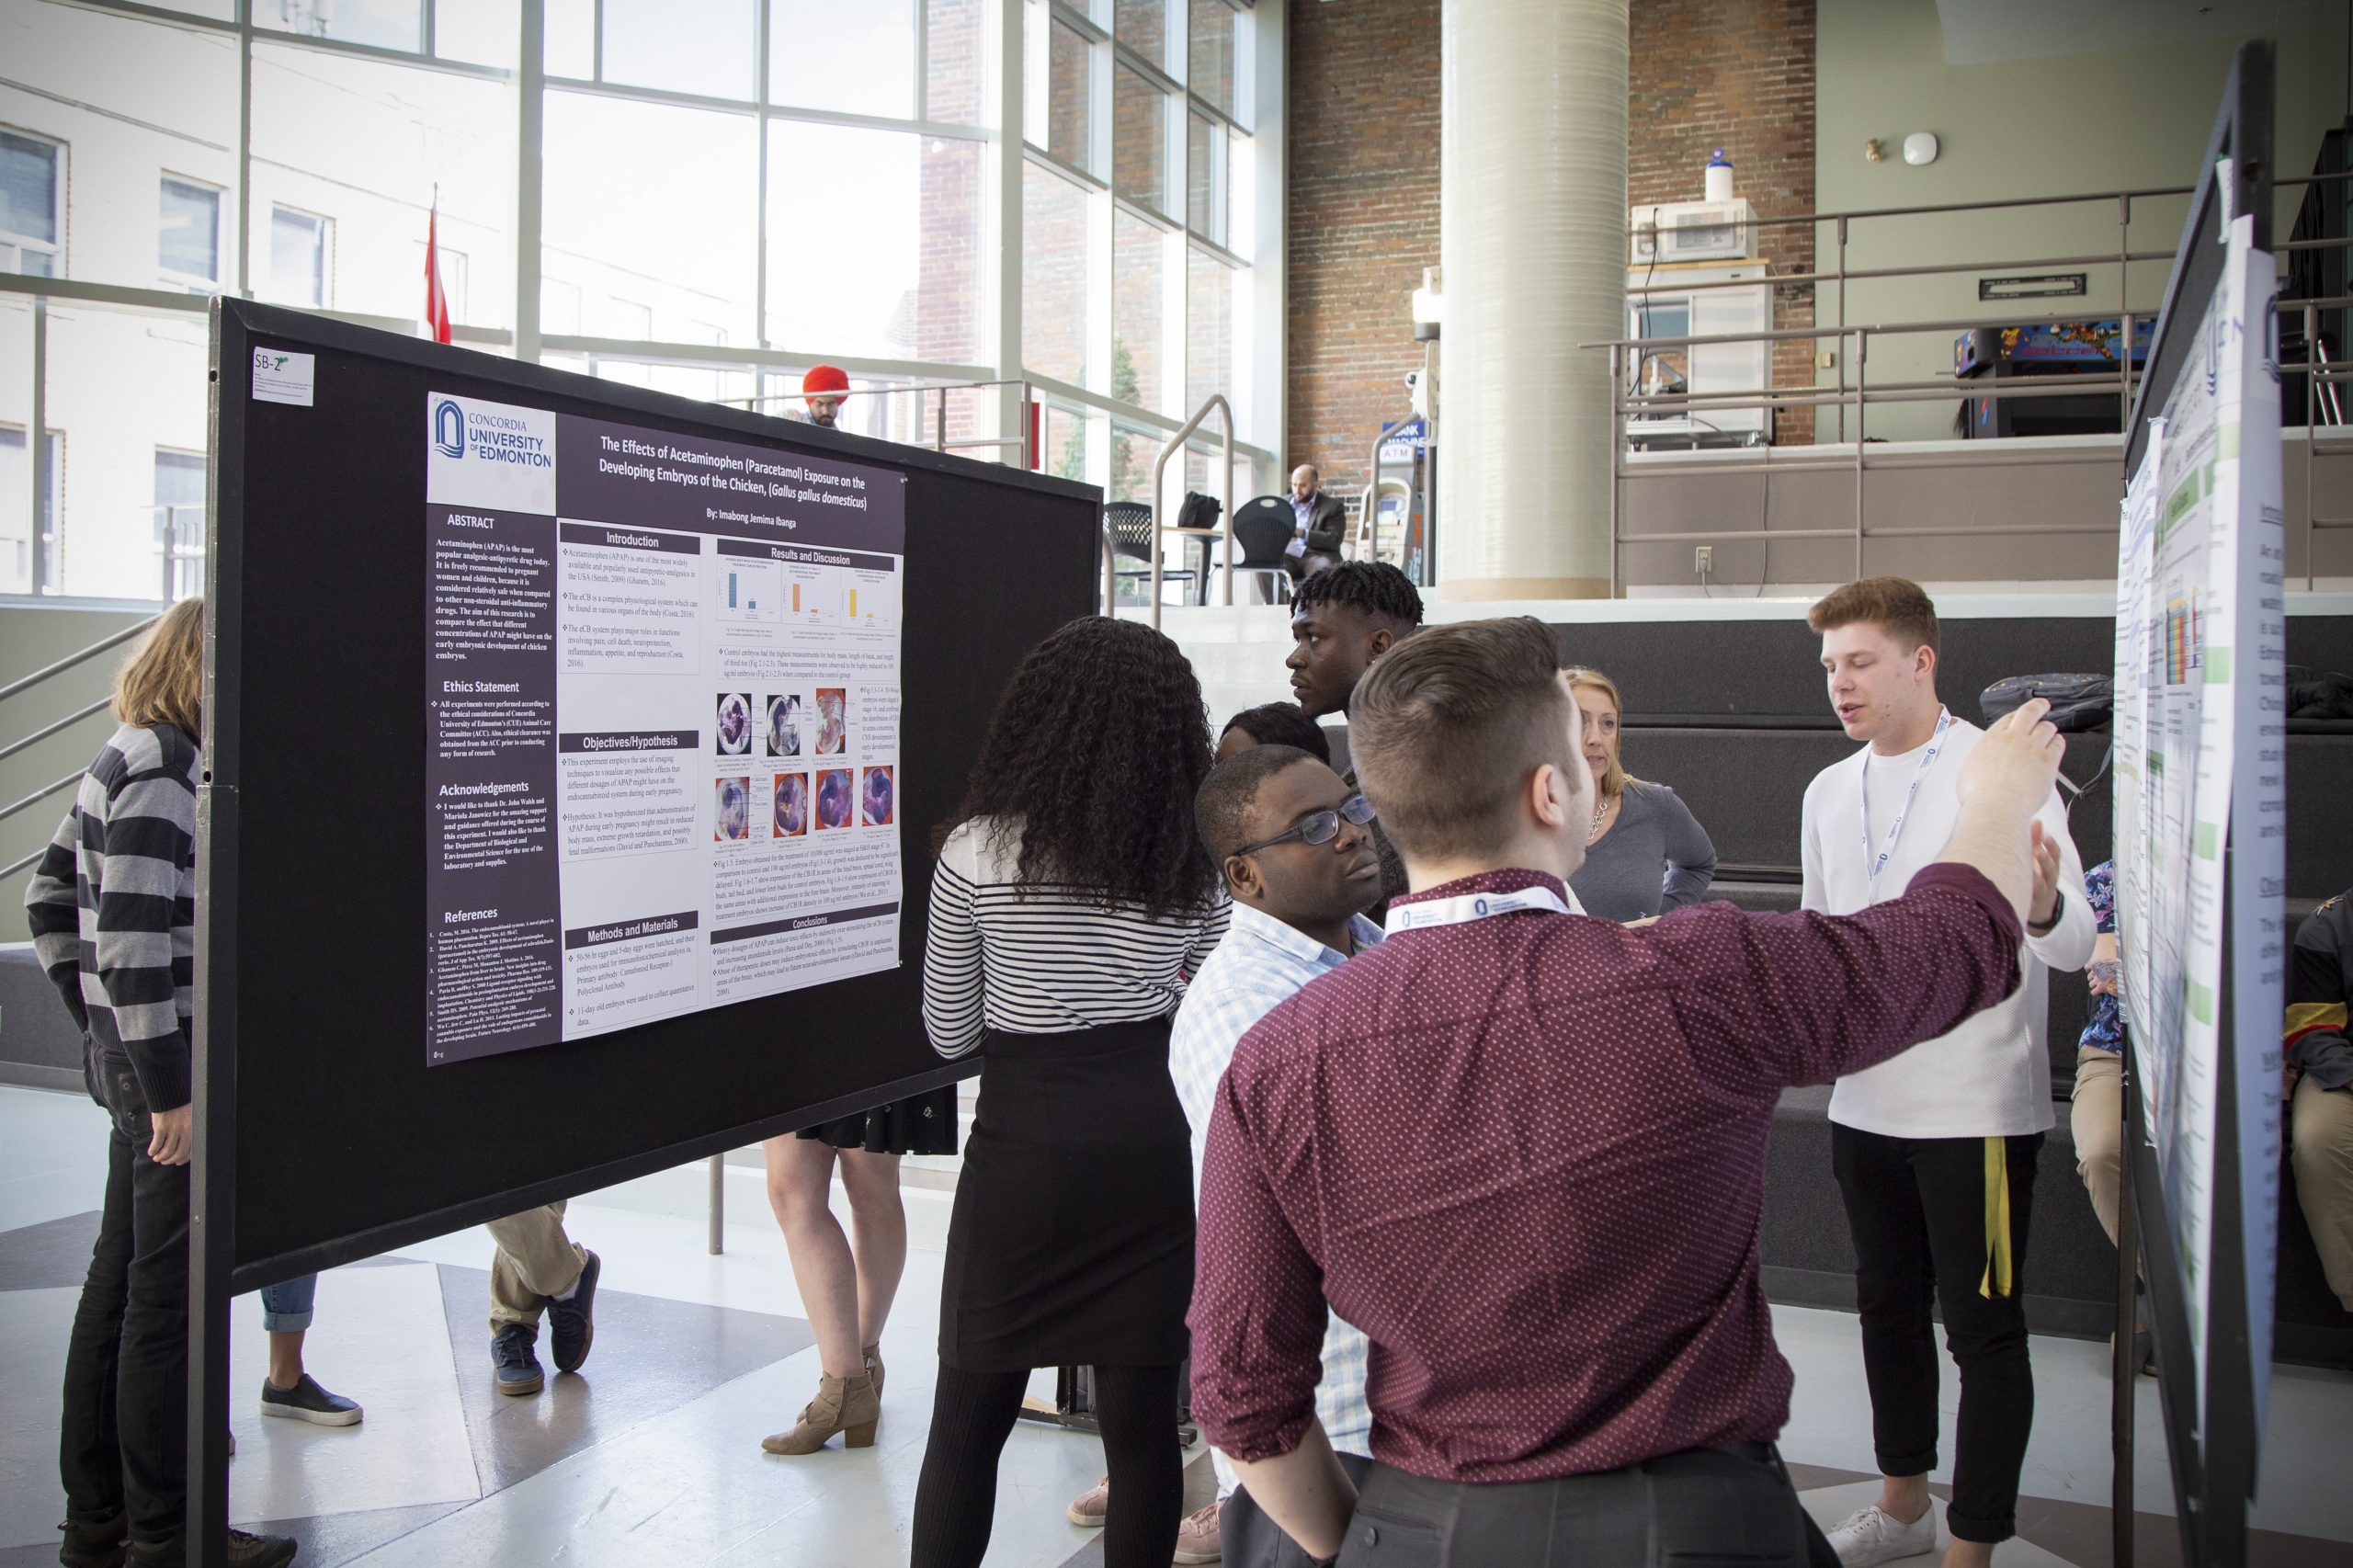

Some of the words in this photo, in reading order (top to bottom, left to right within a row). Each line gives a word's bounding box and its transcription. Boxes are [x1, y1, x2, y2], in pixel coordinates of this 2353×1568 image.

[255, 354, 281, 371] SB-2
[469, 413, 527, 431] CONCORDIA
[470, 428, 543, 451] UNIVERSITY
[480, 446, 551, 467] EDMONTON
[1383, 448, 1408, 457] ATM
[601, 436, 620, 452] The
[622, 440, 655, 458] Effects
[658, 446, 668, 459] of
[670, 447, 743, 470] Acetaminophen
[745, 458, 803, 481] (Paracetamol)
[804, 468, 839, 486] Exposure
[841, 478, 851, 488] on
[852, 478, 865, 490] the
[599, 458, 655, 481] Developing
[657, 467, 698, 486] Embryos
[700, 474, 710, 487] of
[712, 475, 727, 489] the
[729, 478, 767, 497] Chicken,
[769, 482, 796, 499] (Gallus
[798, 488, 820, 503] gallus
[822, 492, 867, 511] domesticus)
[447, 514, 494, 529] ABSTRACT
[706, 508, 718, 519] By:
[719, 509, 749, 524] Imabong
[750, 513, 774, 526] Jemima
[776, 516, 796, 529] Ibanga
[436, 540, 483, 550] Acetaminophen
[484, 543, 505, 553] (APAP)
[607, 532, 659, 547] Introduction
[436, 552, 461, 560] popular
[520, 557, 532, 566] drug
[534, 558, 550, 567] today.
[771, 547, 797, 560] Results
[799, 551, 812, 562] and
[813, 552, 850, 565] Discussion
[452, 563, 468, 572] freely
[473, 576, 497, 585] children,
[472, 587, 496, 596] relatively
[524, 590, 550, 598] compared
[501, 599, 548, 609] anti-inflammatory
[436, 607, 458, 616] drugs.
[507, 632, 521, 640] might
[436, 641, 454, 650] early
[456, 641, 485, 650] embryonic
[487, 642, 520, 651] development
[436, 652, 467, 661] embryos.
[444, 681, 473, 692] Ethics
[475, 682, 519, 692] Statement
[451, 701, 483, 709] experiments
[496, 701, 521, 709] performed
[522, 700, 544, 709] according
[440, 721, 470, 729] University
[506, 719, 522, 728] (CUE)
[583, 735, 678, 751] Objectives/Hypothesis
[439, 782, 529, 796] Acknowledgements
[445, 908, 498, 923] References
[793, 916, 828, 929] Conclusions
[588, 927, 623, 942] Methods
[625, 924, 640, 936] and
[642, 918, 678, 933] Materials
